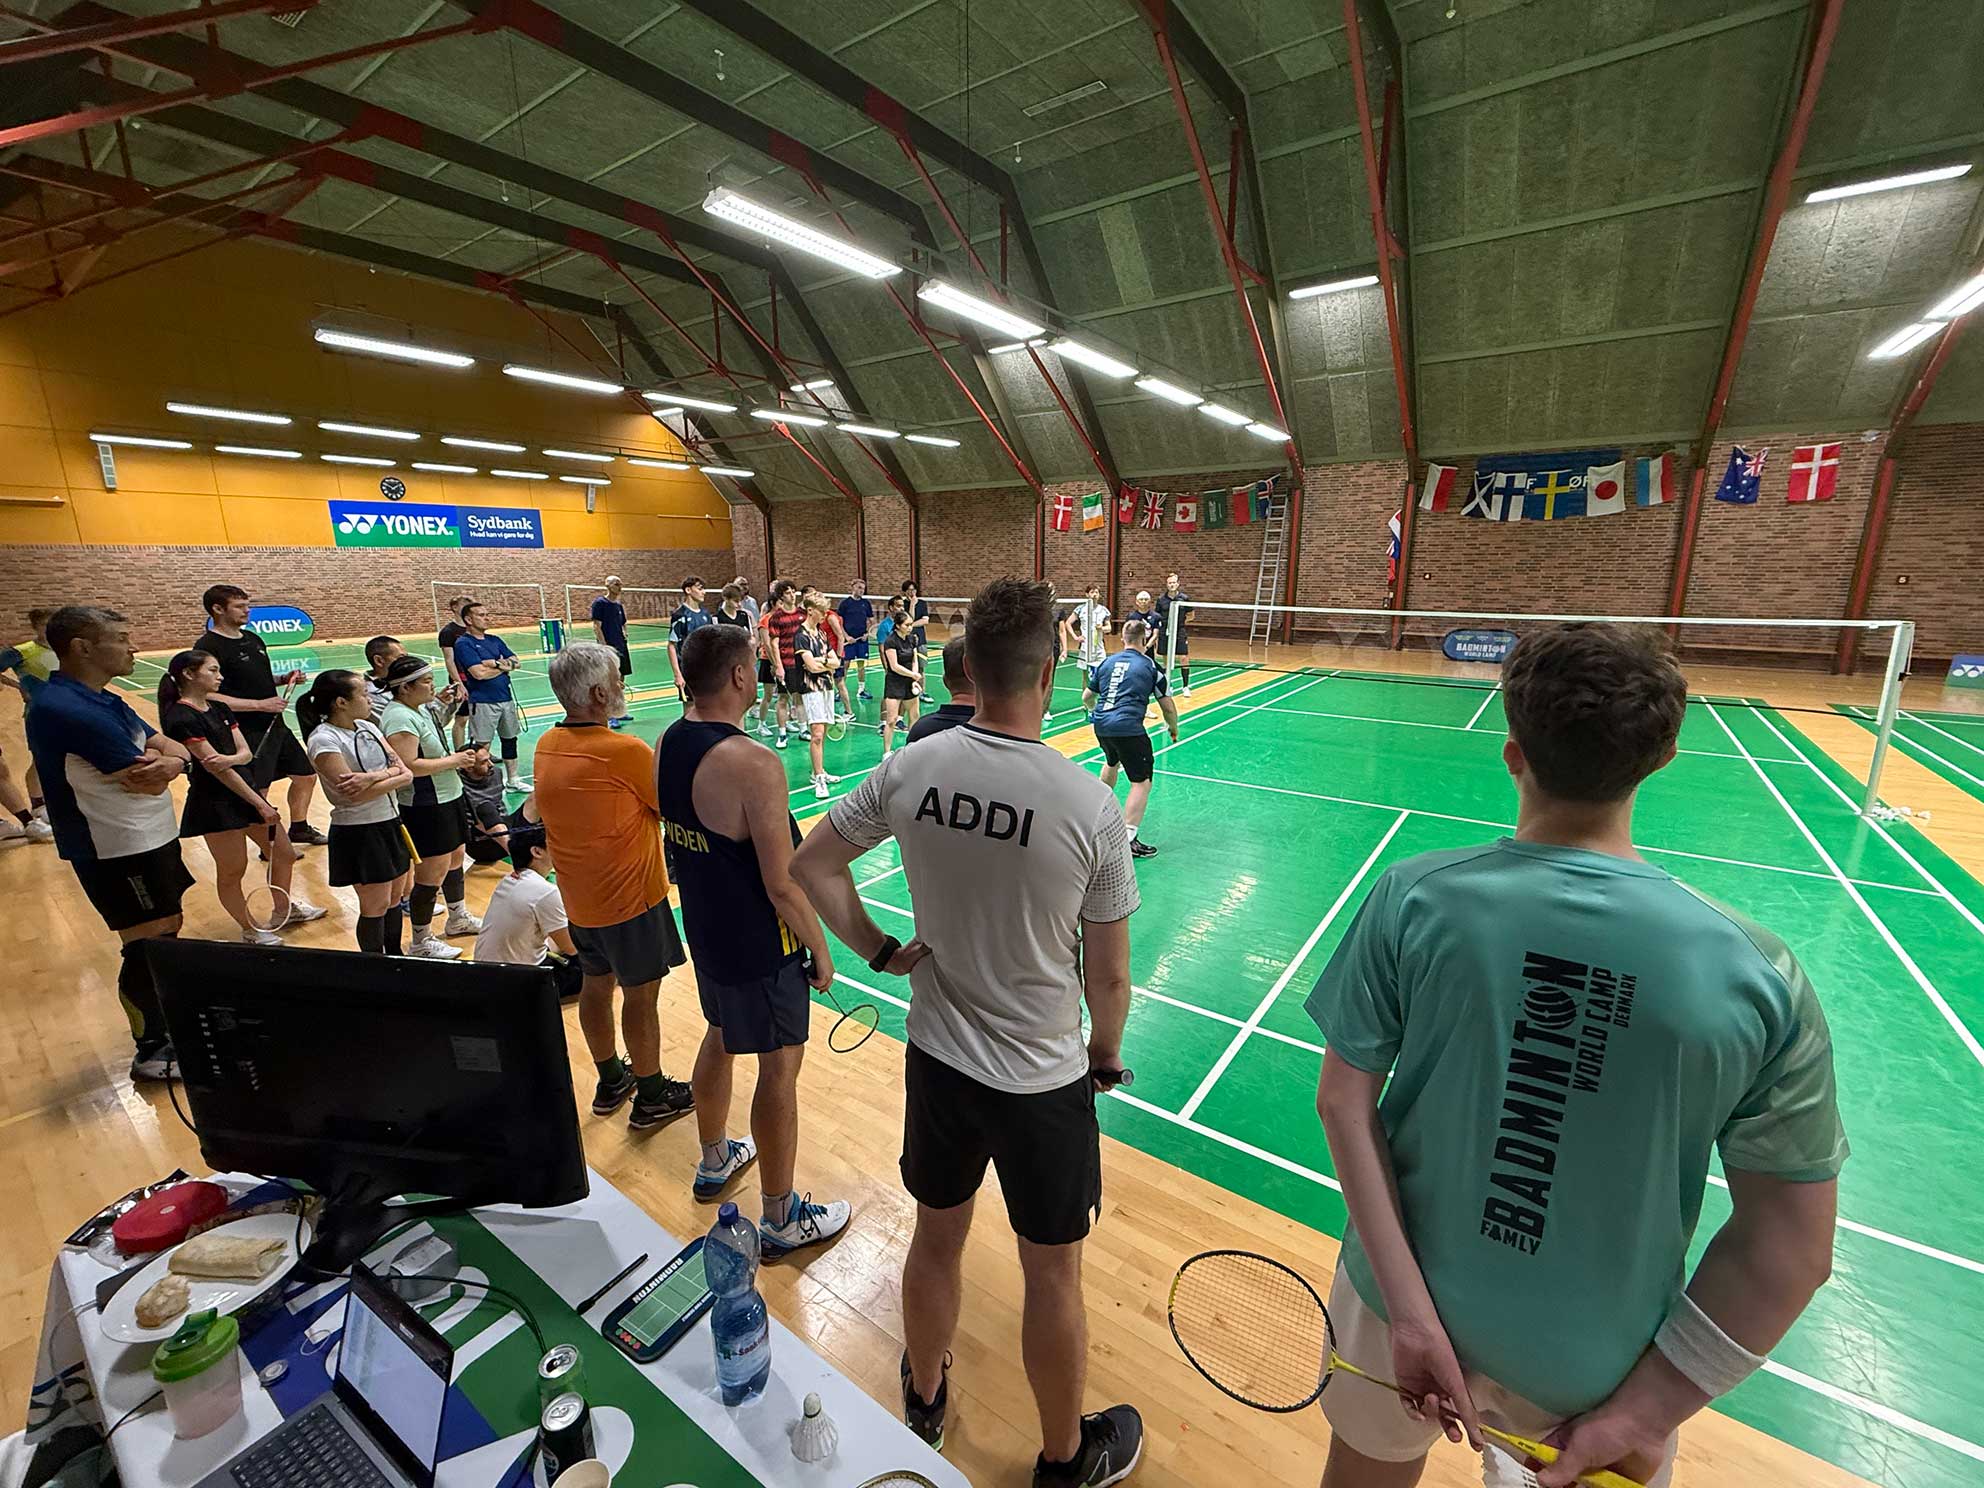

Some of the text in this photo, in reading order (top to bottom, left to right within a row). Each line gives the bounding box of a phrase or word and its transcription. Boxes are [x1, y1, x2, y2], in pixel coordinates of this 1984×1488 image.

[381, 515, 449, 536] YONEX
[467, 515, 533, 531] Sydbank
[251, 619, 304, 633] YONEX
[663, 818, 710, 853] WEDEN
[915, 786, 1035, 848] ADDI
[1613, 974, 1637, 1028] DENMARK
[1573, 966, 1618, 1093] WORLD CAMP
[1483, 951, 1589, 1240] BADMINTON
